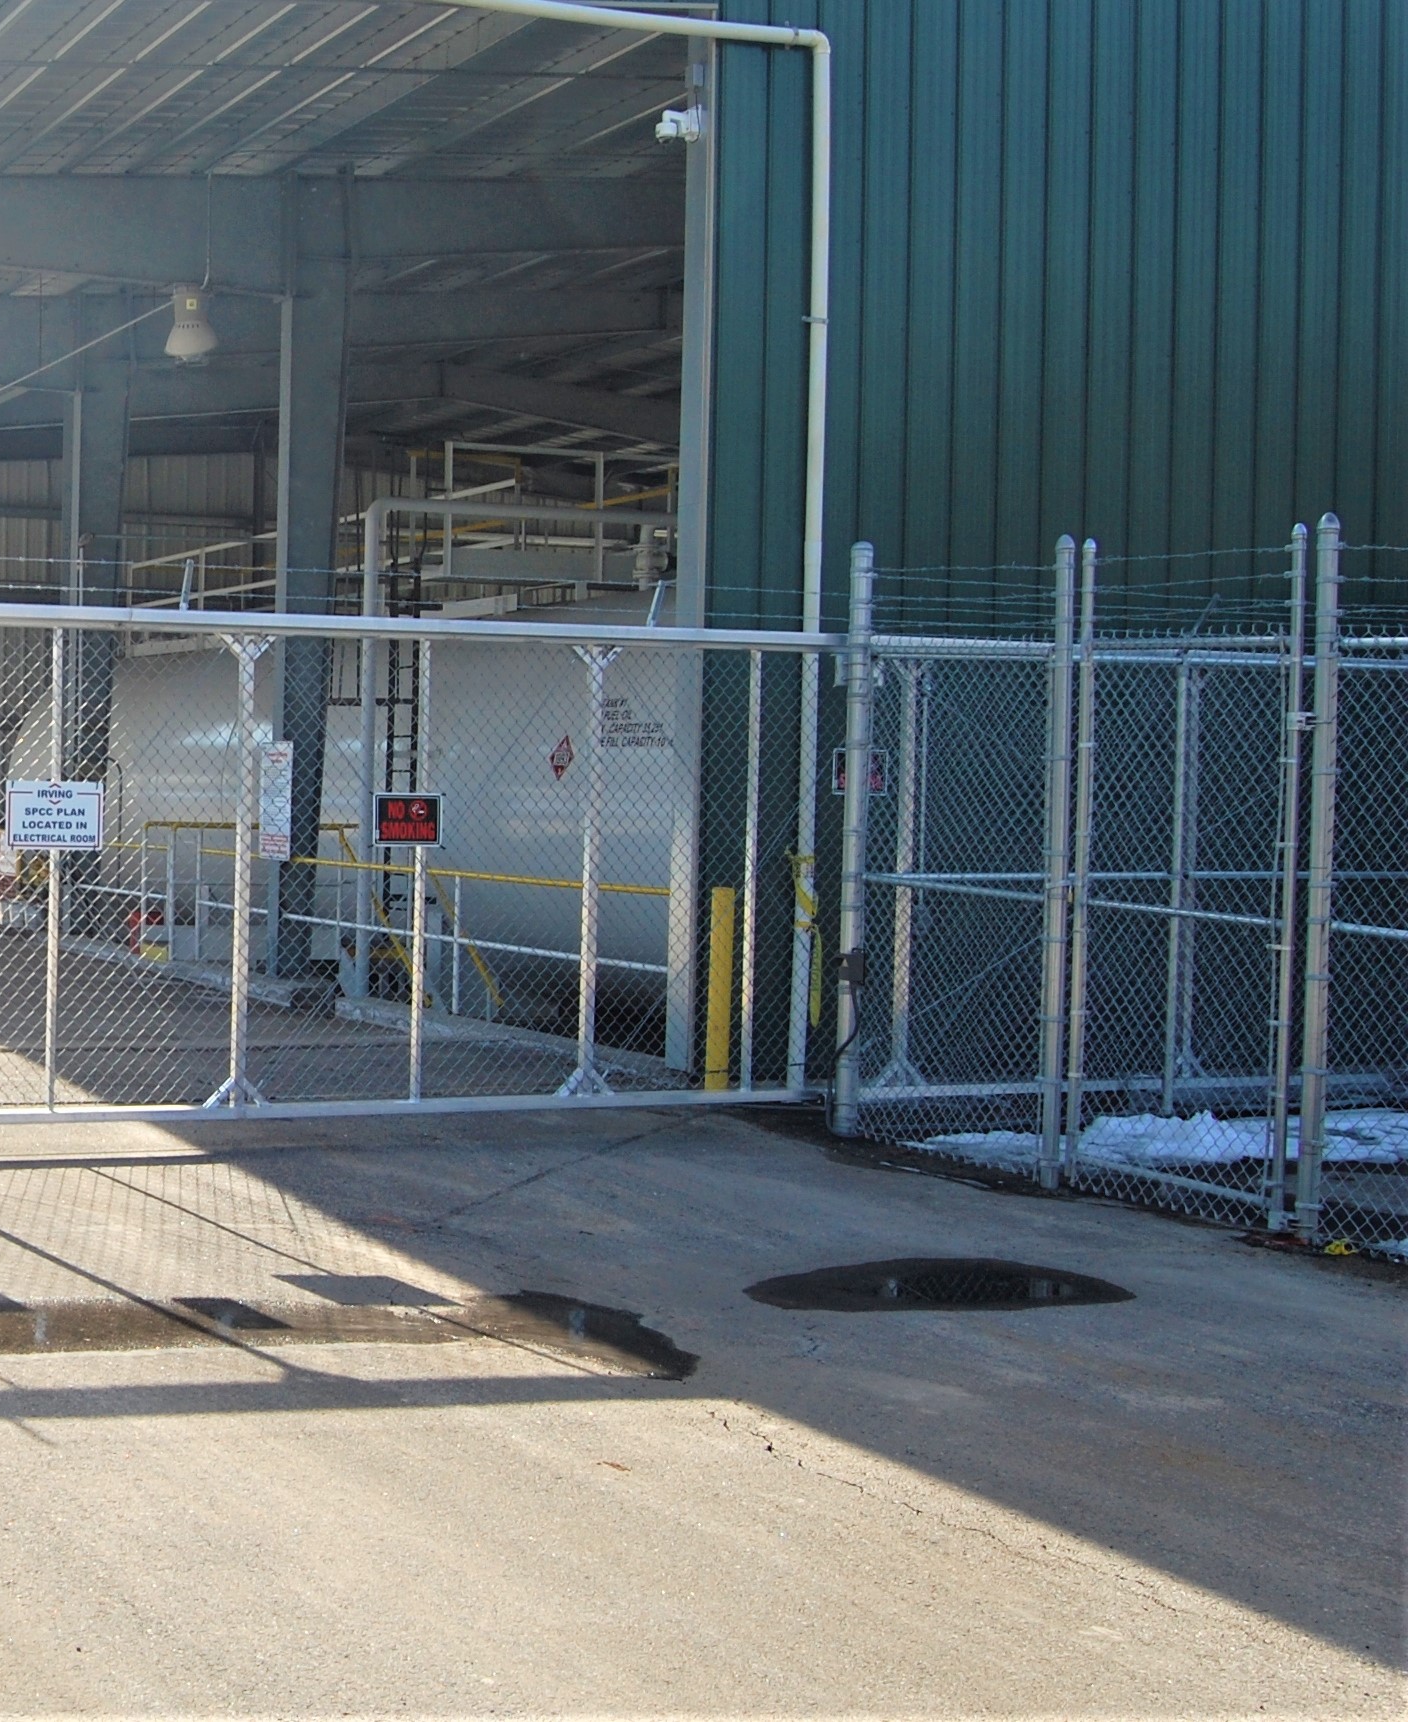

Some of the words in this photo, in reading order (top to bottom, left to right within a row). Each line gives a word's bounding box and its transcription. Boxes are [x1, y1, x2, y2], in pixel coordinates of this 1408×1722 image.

[37, 789, 74, 799] IRVING
[24, 807, 53, 816] SPCC
[56, 807, 86, 817] PLAN
[387, 800, 405, 820] NO
[22, 820, 73, 830] LOCATED
[76, 821, 88, 831] IN
[381, 821, 436, 840] SMOKING
[12, 833, 68, 843] ELECTRICAL
[70, 834, 96, 843] ROOM
